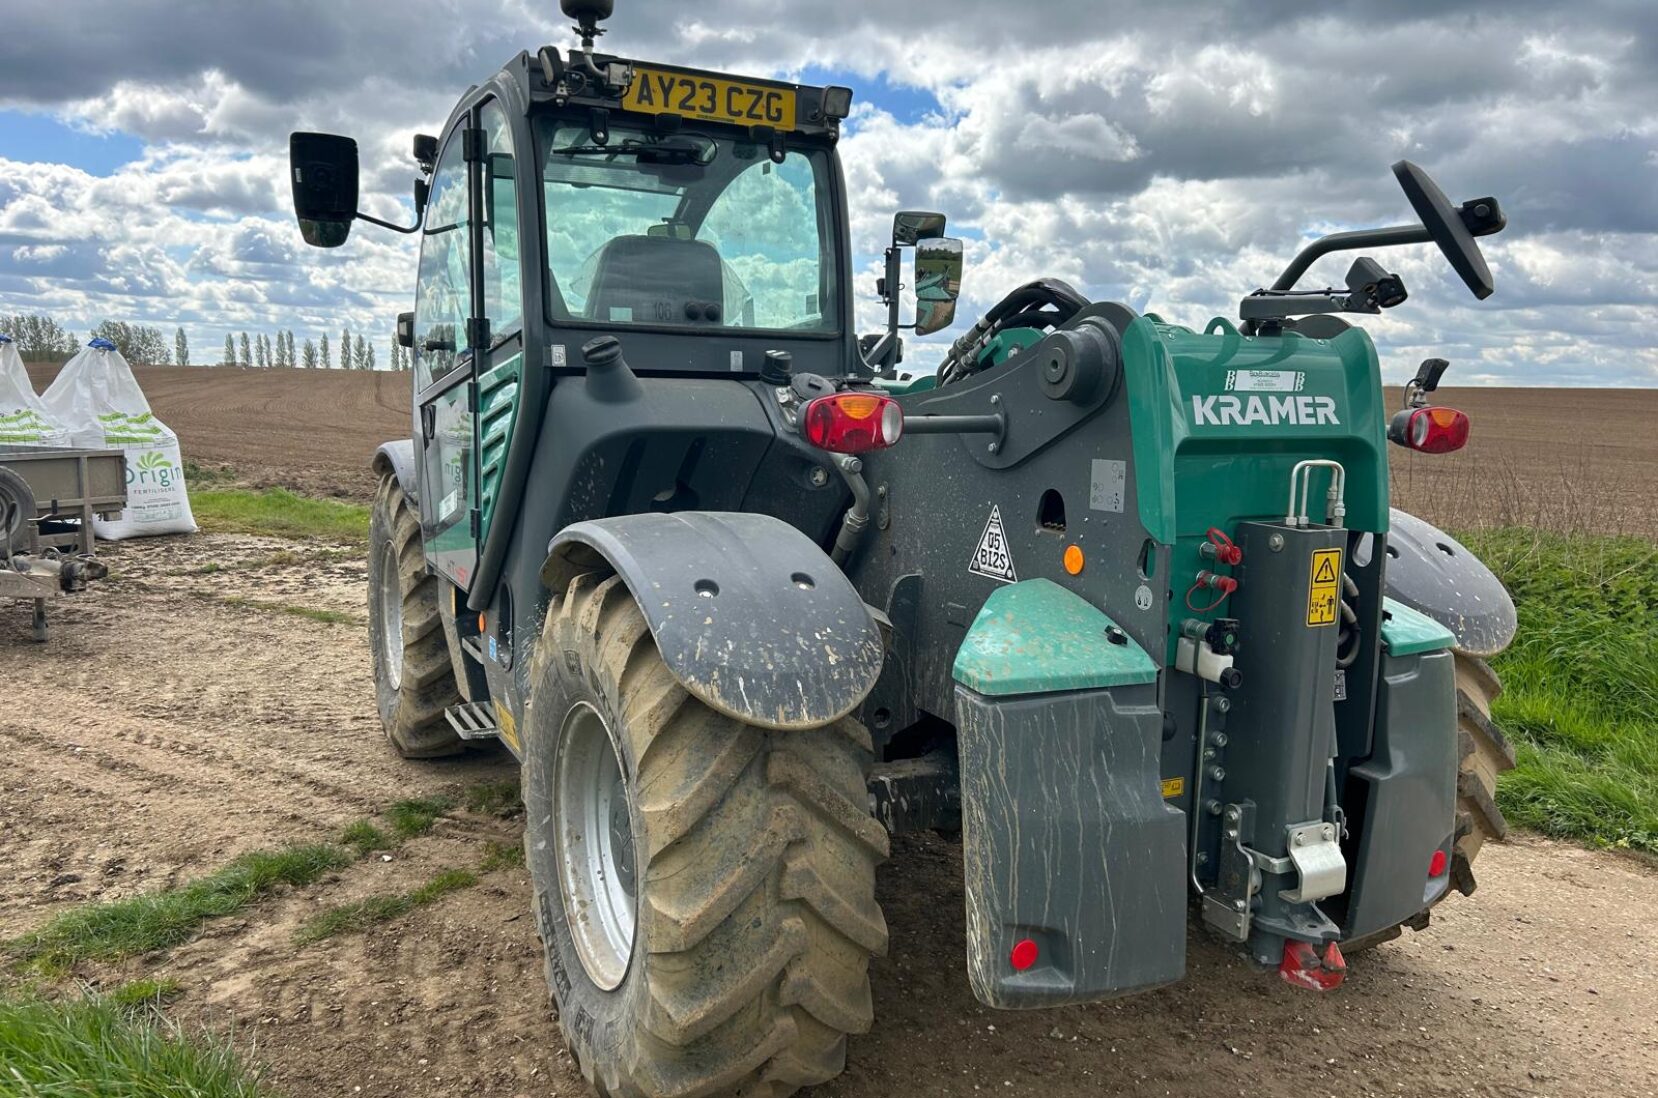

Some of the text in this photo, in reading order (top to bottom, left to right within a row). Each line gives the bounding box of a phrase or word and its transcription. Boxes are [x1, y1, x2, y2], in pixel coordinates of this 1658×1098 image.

[636, 73, 783, 122] AY23 CZG
[1192, 395, 1341, 425] KRAMER
